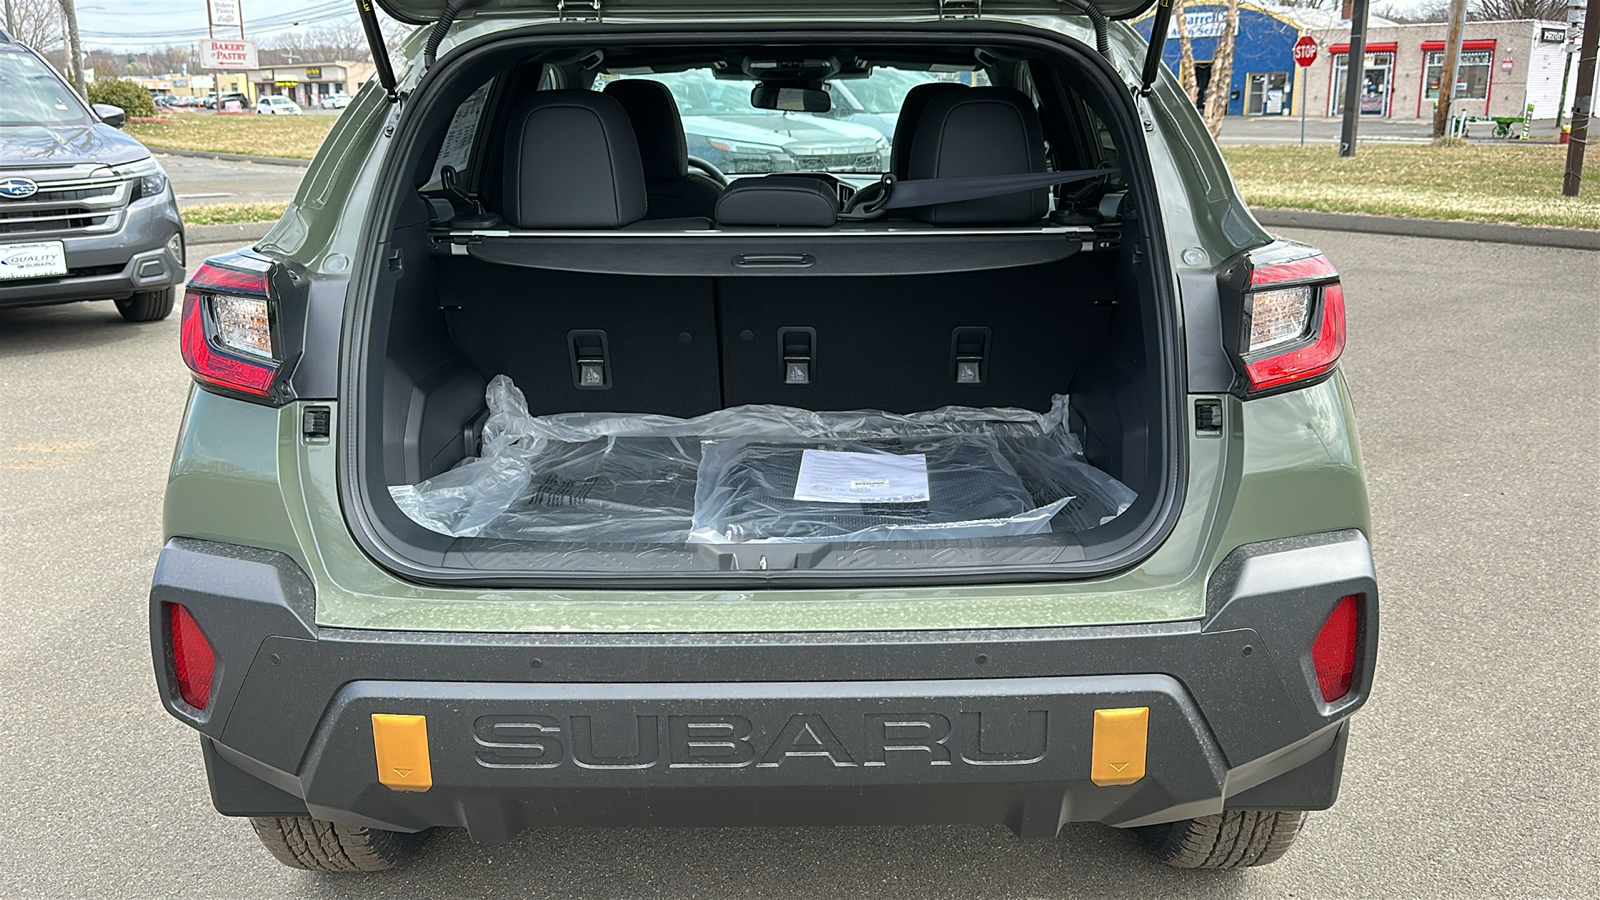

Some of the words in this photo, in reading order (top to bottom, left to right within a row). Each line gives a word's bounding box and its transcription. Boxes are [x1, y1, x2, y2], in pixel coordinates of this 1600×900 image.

[211, 42, 246, 51] BAKERY
[216, 51, 247, 60] PASTRY
[1295, 45, 1316, 59] STOP
[11, 254, 58, 263] QUALITY
[472, 710, 1048, 769] SUBARU
